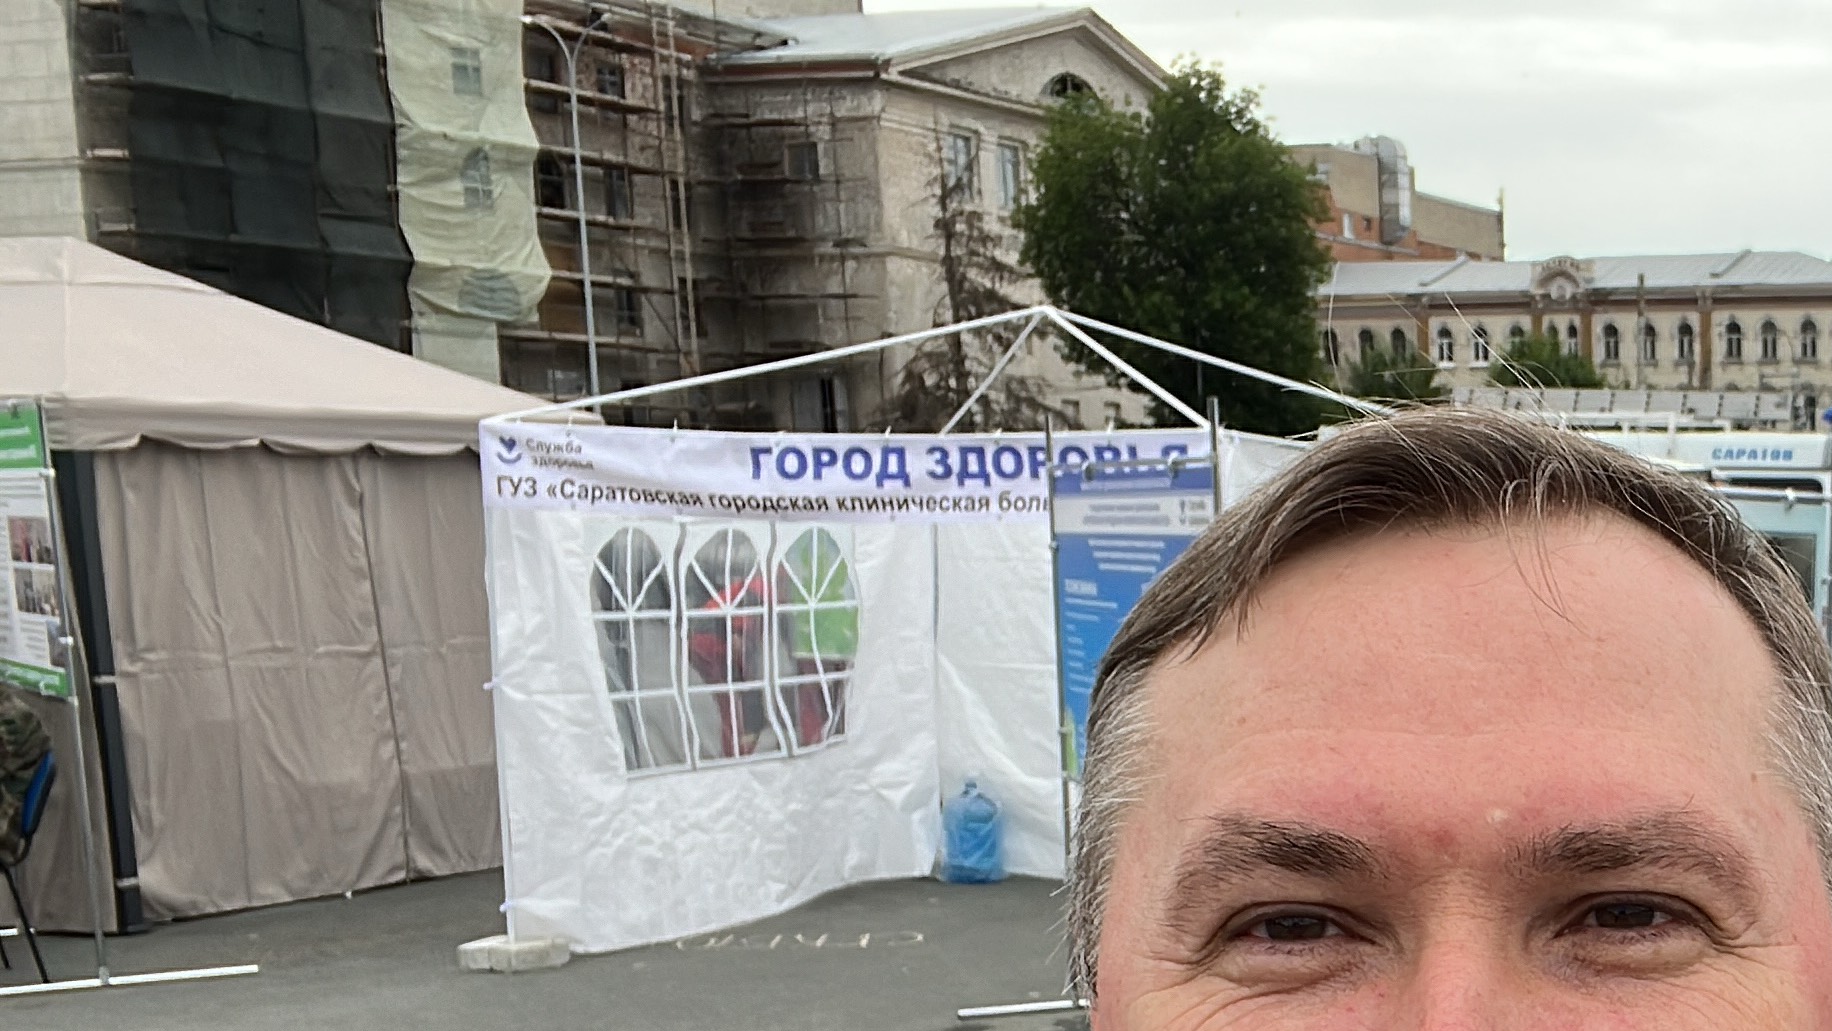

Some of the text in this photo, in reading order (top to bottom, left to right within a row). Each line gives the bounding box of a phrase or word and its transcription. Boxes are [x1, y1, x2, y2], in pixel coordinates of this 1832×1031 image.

[526, 438, 582, 454] Служба
[750, 445, 911, 488] ГОРОД
[496, 476, 537, 498] ГУЗ
[547, 478, 703, 506] «Саратовская
[709, 490, 829, 514] городская
[837, 493, 990, 514] клиническая
